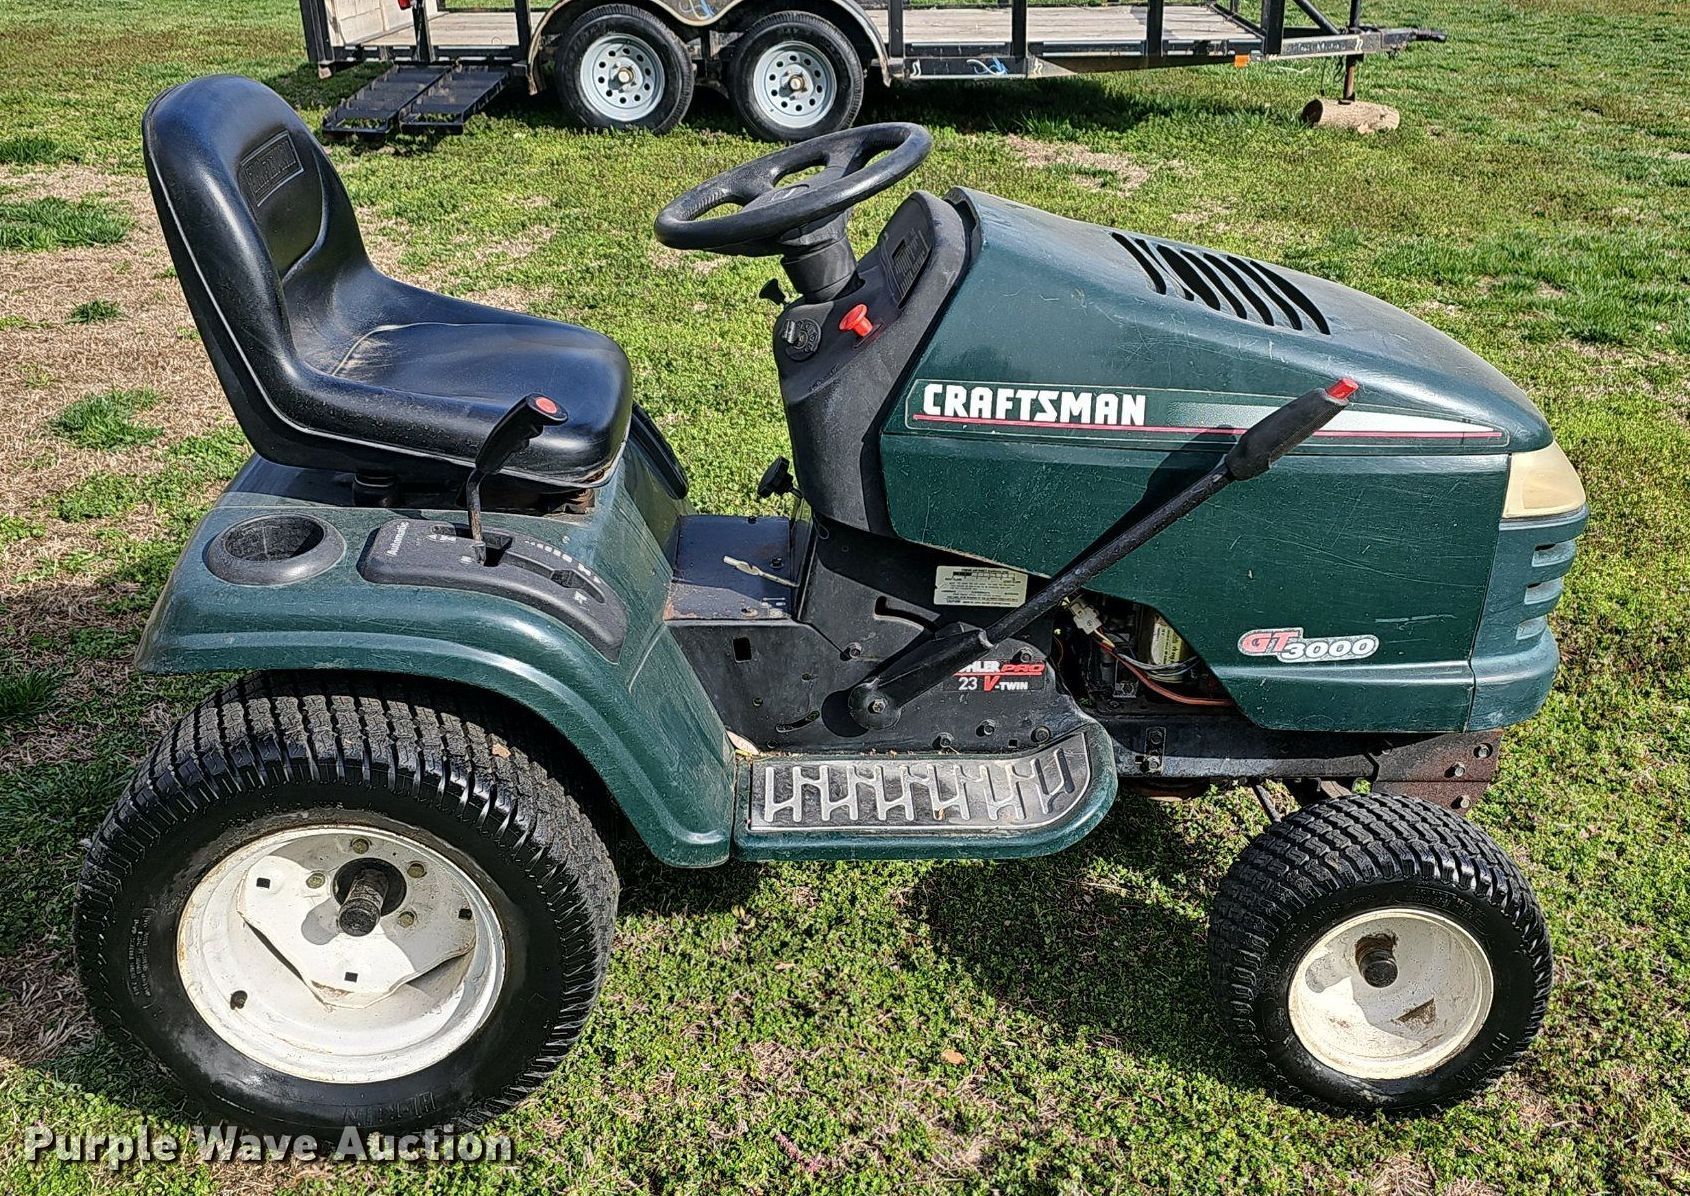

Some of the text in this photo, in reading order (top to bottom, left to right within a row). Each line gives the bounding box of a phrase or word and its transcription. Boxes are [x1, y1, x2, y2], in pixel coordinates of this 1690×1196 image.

[922, 383, 1146, 426] CRAFTSMAN
[1241, 630, 1377, 660] GT 3000
[1000, 663, 1046, 673] PRO
[958, 675, 1029, 692] 23 V-TWIN
